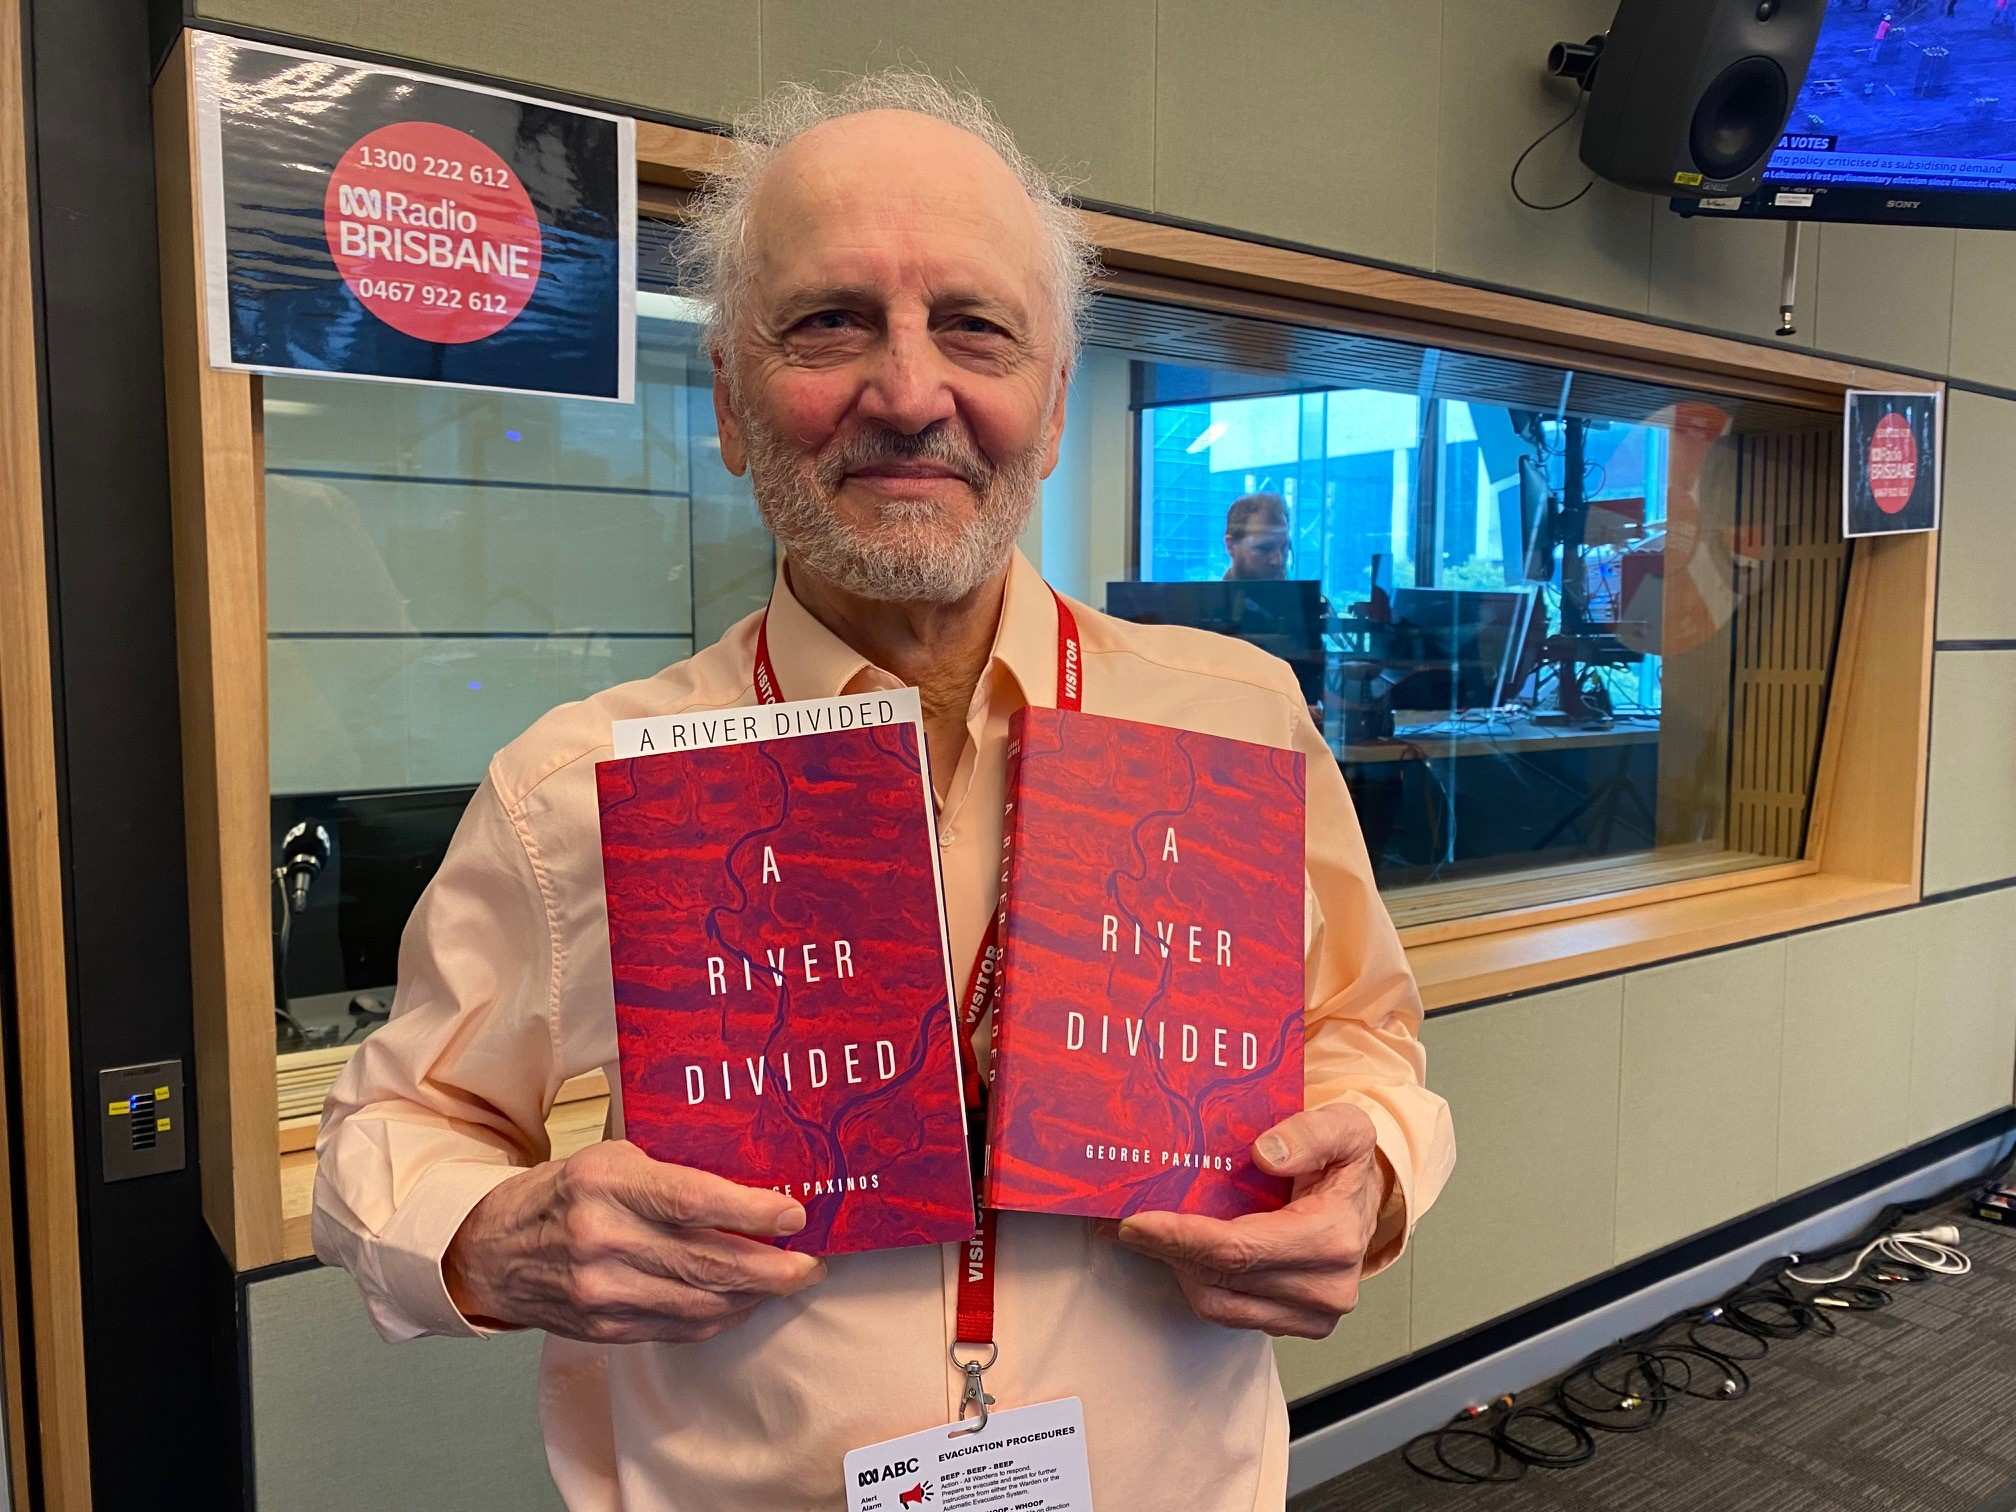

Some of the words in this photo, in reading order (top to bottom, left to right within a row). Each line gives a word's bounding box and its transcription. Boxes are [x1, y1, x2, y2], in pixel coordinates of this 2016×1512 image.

[1791, 136, 1830, 149] VOTES
[360, 147, 416, 173] 1300
[423, 156, 463, 182] 222
[470, 163, 510, 188] 612
[1791, 154, 1825, 168] policy
[1827, 156, 1879, 168] criticised
[1896, 159, 1957, 172] subsidising
[1959, 162, 2005, 174] demand
[387, 193, 477, 234] Radio
[1886, 200, 1921, 209] SONY
[340, 221, 529, 280] BRISBANE
[360, 278, 415, 303] 0467
[422, 285, 461, 309] 922
[469, 292, 508, 314] 612
[757, 661, 776, 704] VISITO
[1065, 638, 1077, 699] VISITOR
[640, 729, 655, 752] A
[672, 716, 758, 748] RIVER
[775, 701, 894, 736] DIVIDED
[1005, 803, 1013, 816] A
[1162, 827, 1179, 863] A
[762, 846, 782, 884] A
[1102, 914, 1232, 968] RIVER
[707, 939, 854, 996] RIVER
[966, 945, 997, 1023] VISITOR
[1066, 1011, 1258, 1070] DIVIDED
[685, 1040, 897, 1105] DIVIDED
[1085, 1144, 1151, 1165] GEORGE
[1161, 1151, 1233, 1172] PAXINOS
[803, 1174, 879, 1196] PAXINOS
[938, 1440, 1003, 1462] EVACUATION
[1006, 1426, 1076, 1447] PROCEDURES
[881, 1458, 920, 1482] ABC
[940, 1471, 960, 1482] BEEP
[967, 1465, 987, 1476] BEEP
[993, 1460, 1014, 1470] BEEP
[941, 1480, 959, 1490] Action
[973, 1472, 998, 1483] Wardens
[942, 1487, 964, 1497] Prepare
[973, 1480, 999, 1490] evacuate
[1001, 1476, 1012, 1484] and
[1037, 1467, 1057, 1476] further
[861, 1495, 877, 1504] Alert
[943, 1501, 972, 1512] Automatic
[972, 1494, 1005, 1506] Evacuation
[976, 1489, 990, 1498] from
[991, 1485, 1007, 1494] either
[1009, 1482, 1018, 1490] the
[1019, 1479, 1042, 1488] Warden
[1015, 1499, 1043, 1510] WHOOP
[862, 1502, 882, 1512] Alarm
